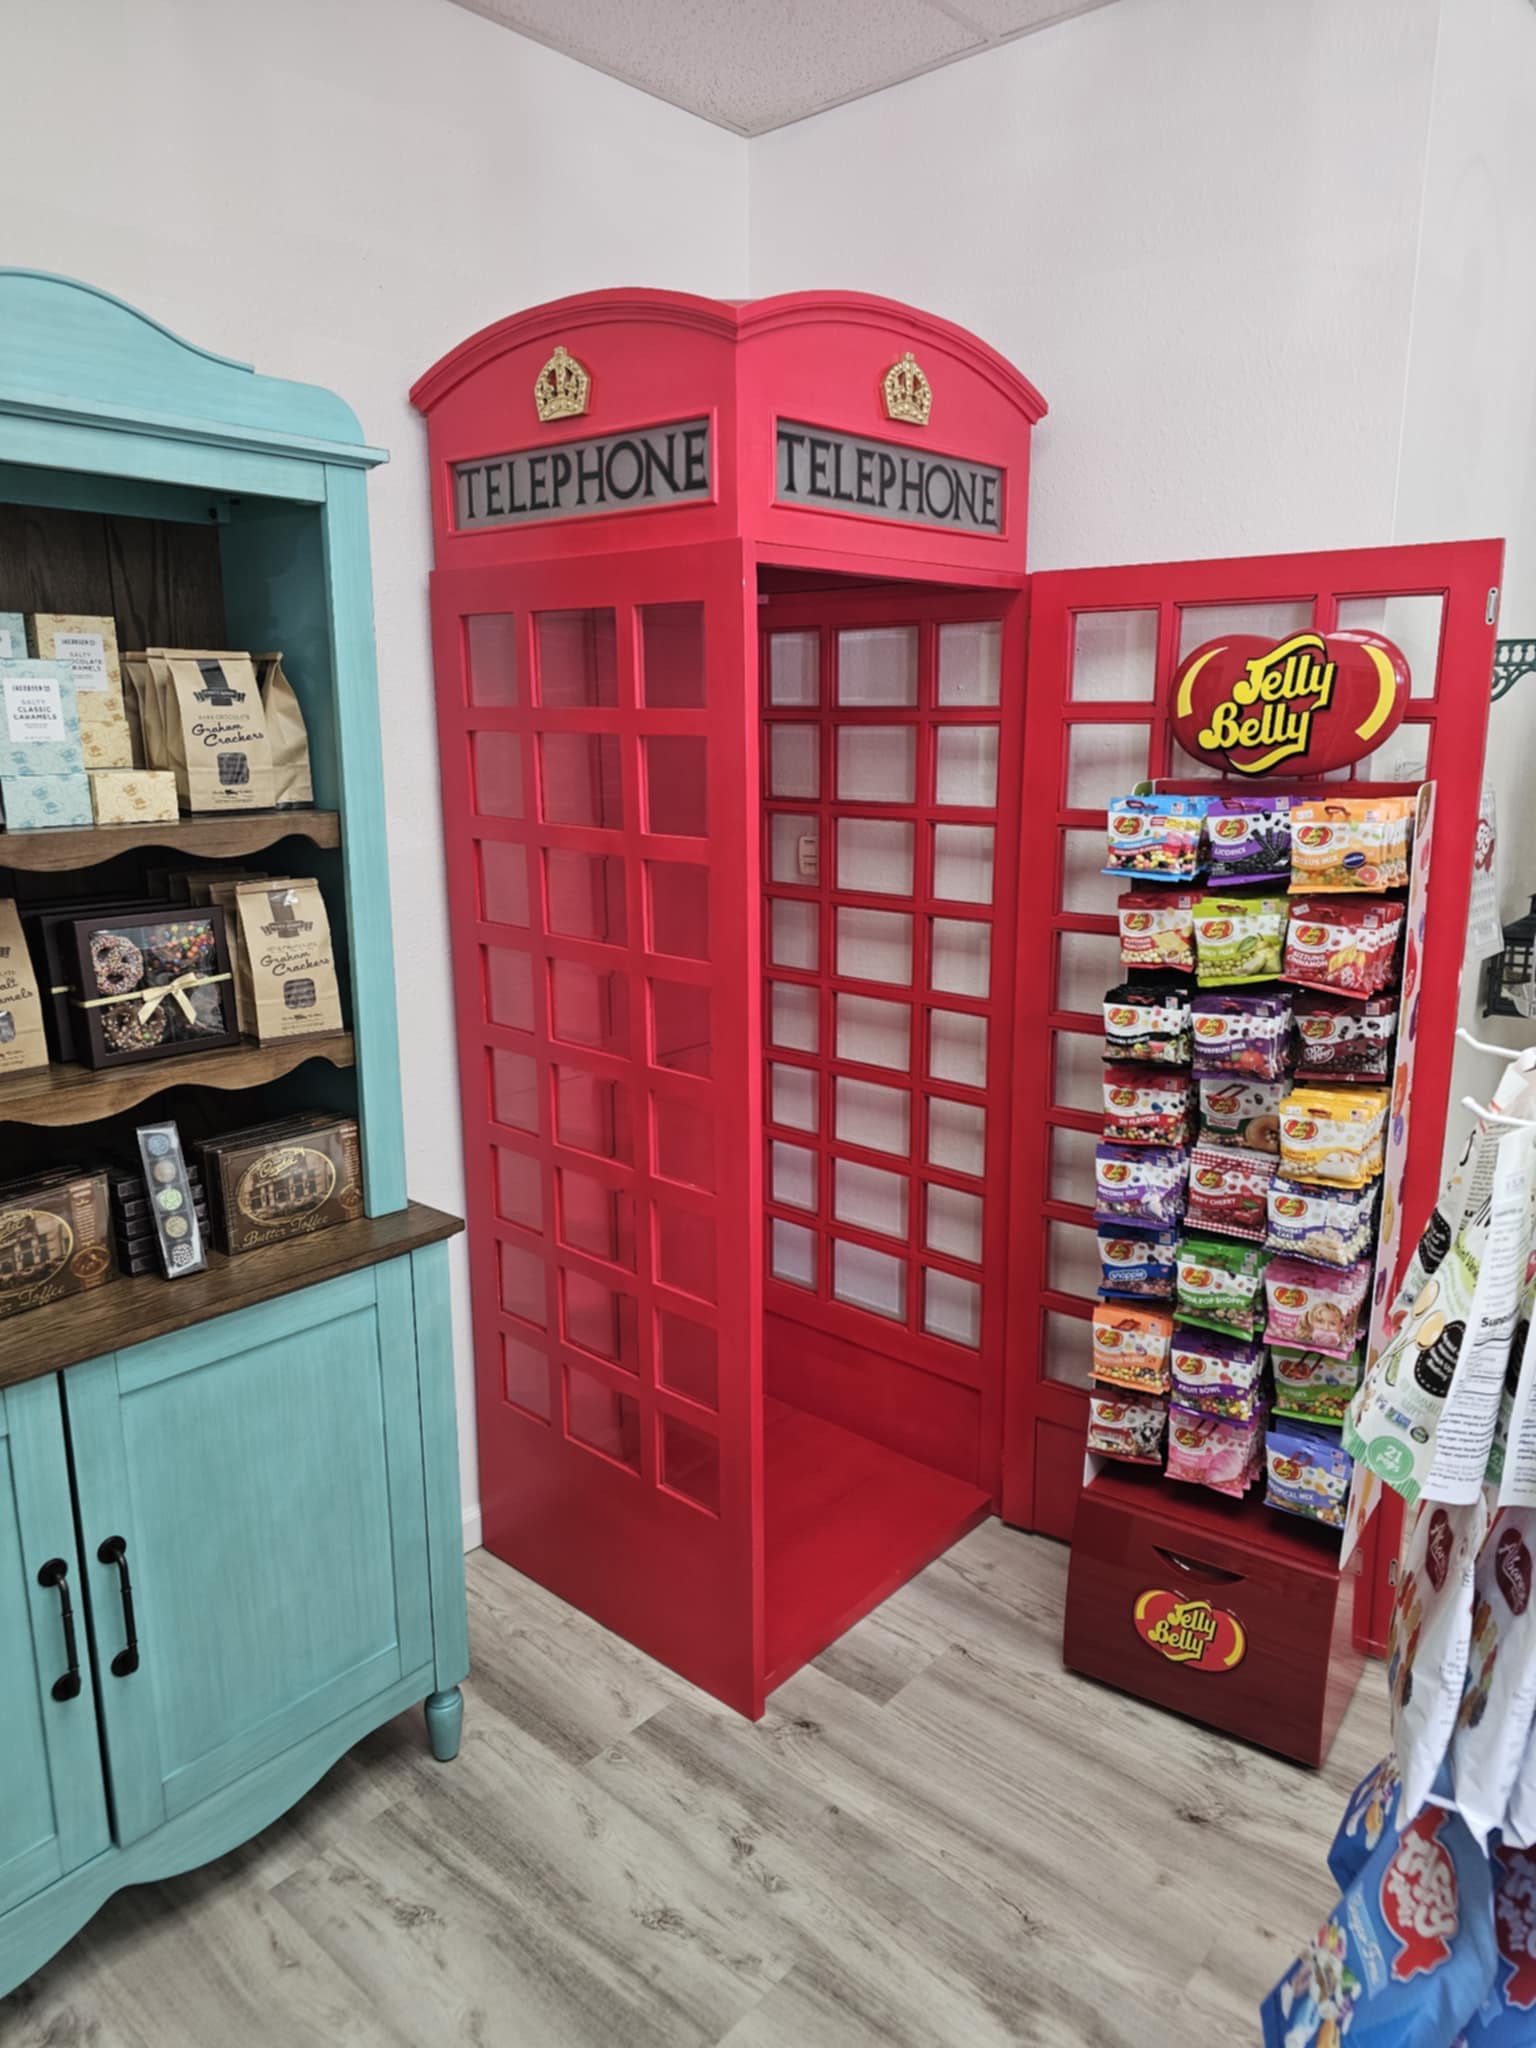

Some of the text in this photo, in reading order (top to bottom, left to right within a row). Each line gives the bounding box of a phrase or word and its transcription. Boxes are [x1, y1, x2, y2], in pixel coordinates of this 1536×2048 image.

[456, 428, 709, 521] TELEPHONE
[777, 430, 998, 527] TELEPHONE
[1233, 637, 1337, 711] Jelly
[13, 713, 58, 721] CARAMELS
[16, 705, 52, 714] CLASSIC
[191, 722, 243, 737] Graham
[1198, 702, 1314, 769] Belly
[203, 730, 265, 747] Crackers
[1214, 846, 1247, 857] LICORICE
[260, 951, 311, 967] Graham
[271, 957, 331, 977] Crackers
[1129, 1114, 1161, 1126] FLAVORS
[1209, 1196, 1236, 1206] CHERRY
[242, 1213, 330, 1248] Butter Toffee
[1110, 1269, 1146, 1280] snapple
[1199, 1296, 1214, 1306] POP
[1215, 1296, 1246, 1306] SHOPPE
[1177, 1383, 1222, 1395] FRUIT BOWL
[1383, 1444, 1403, 1464] 21
[1298, 1492, 1314, 1501] MIX
[1167, 1602, 1218, 1642] Jelly
[1147, 1619, 1205, 1661] Belly
